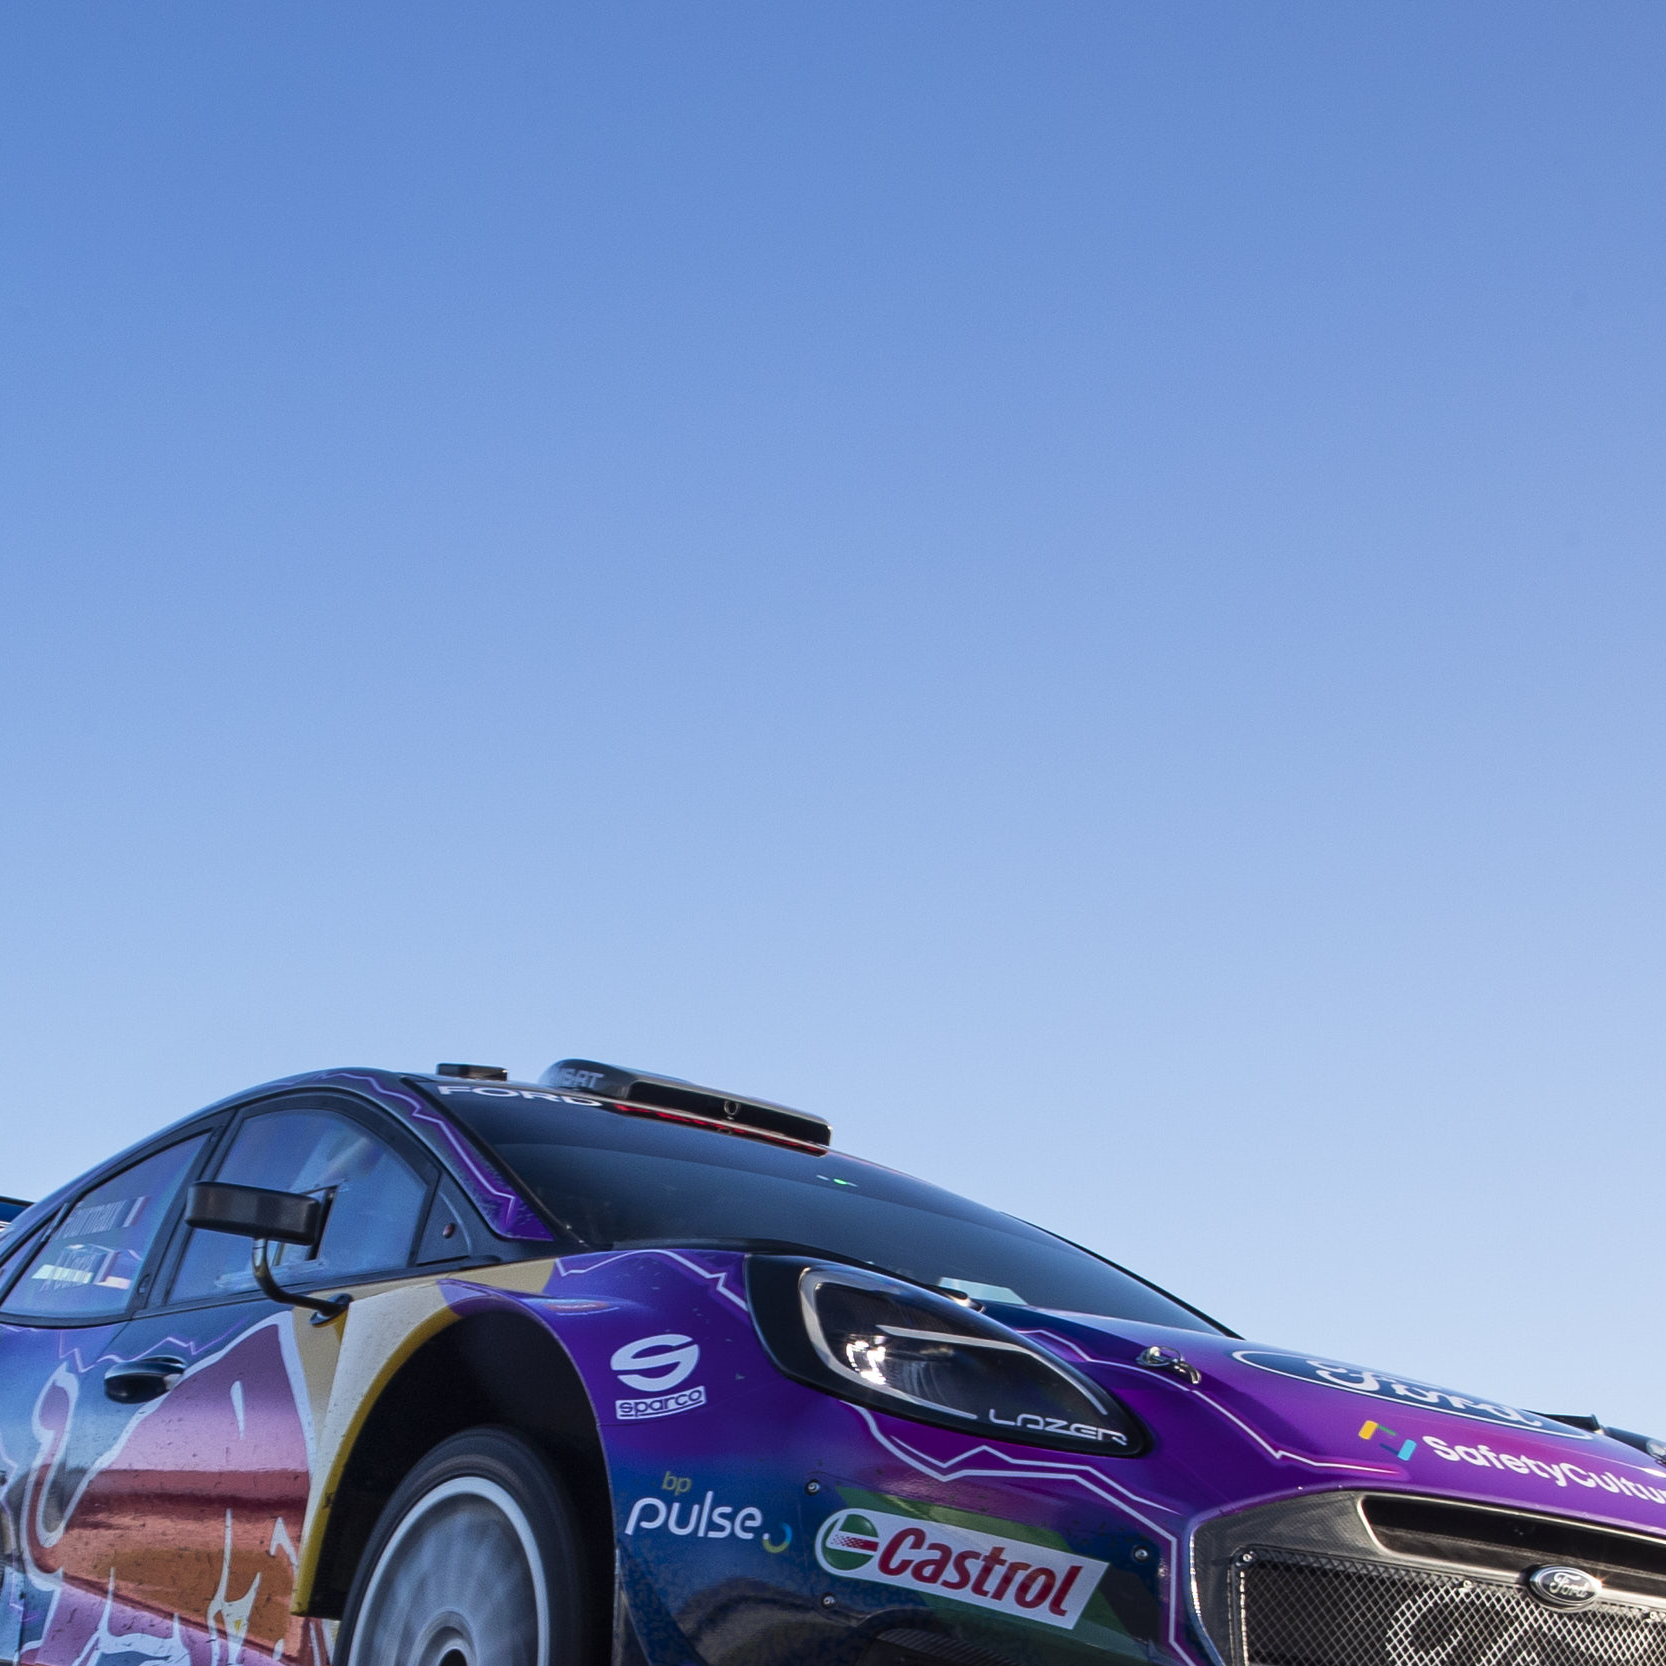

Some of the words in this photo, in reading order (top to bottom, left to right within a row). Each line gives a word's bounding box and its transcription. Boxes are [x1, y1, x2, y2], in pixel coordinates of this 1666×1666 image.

[437, 1085, 603, 1107] FORD
[619, 1389, 703, 1415] sparco
[1306, 1359, 1543, 1427] Ford
[988, 1408, 1128, 1447] LAZER
[660, 1470, 693, 1497] bp
[877, 1527, 1085, 1617] Castrol
[1549, 1572, 1590, 1598] Ford
